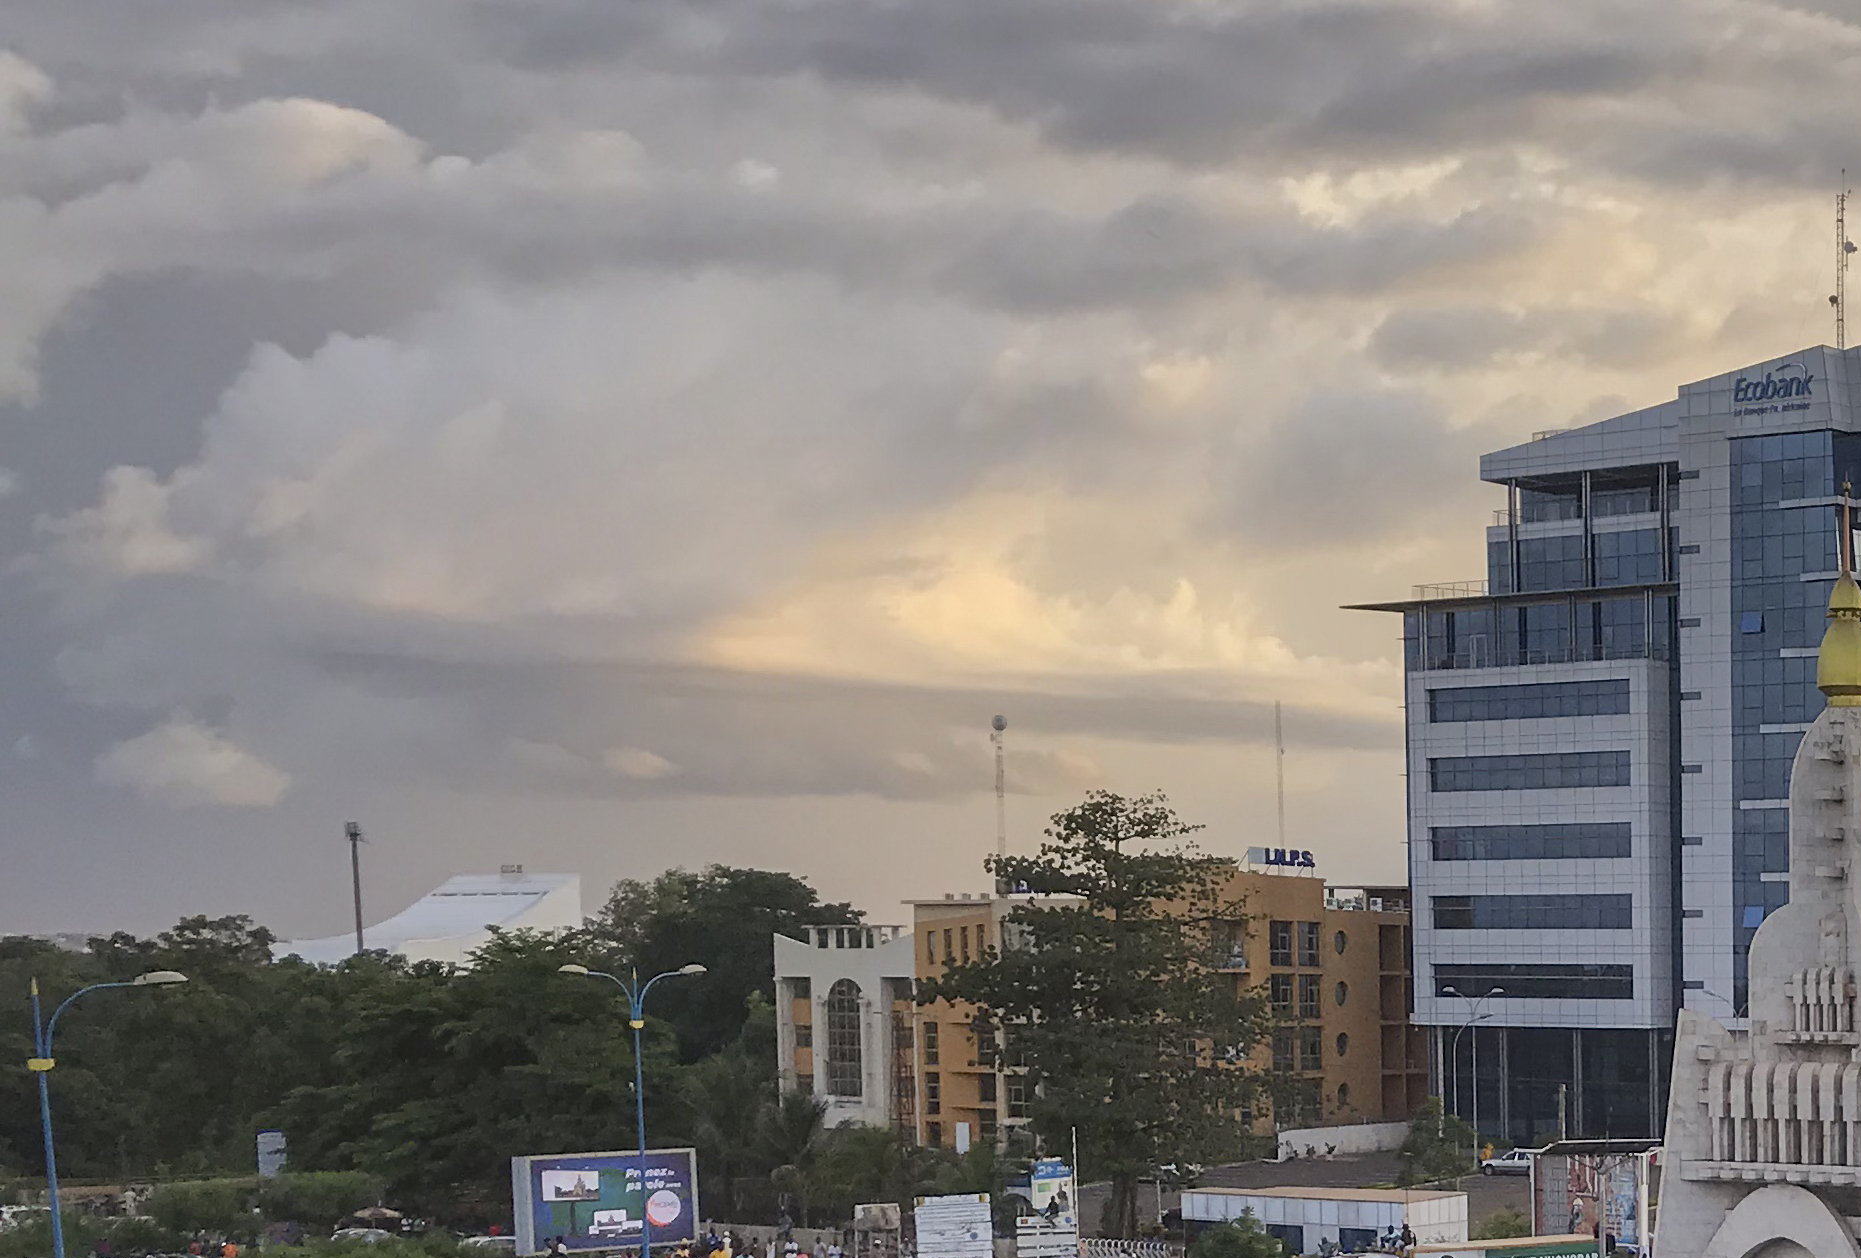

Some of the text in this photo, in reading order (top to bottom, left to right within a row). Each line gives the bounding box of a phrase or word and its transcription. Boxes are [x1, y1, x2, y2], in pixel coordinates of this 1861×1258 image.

[1734, 372, 1815, 402] Ecobank
[625, 1167, 668, 1178] Prnez
[625, 1179, 665, 1193] paole
